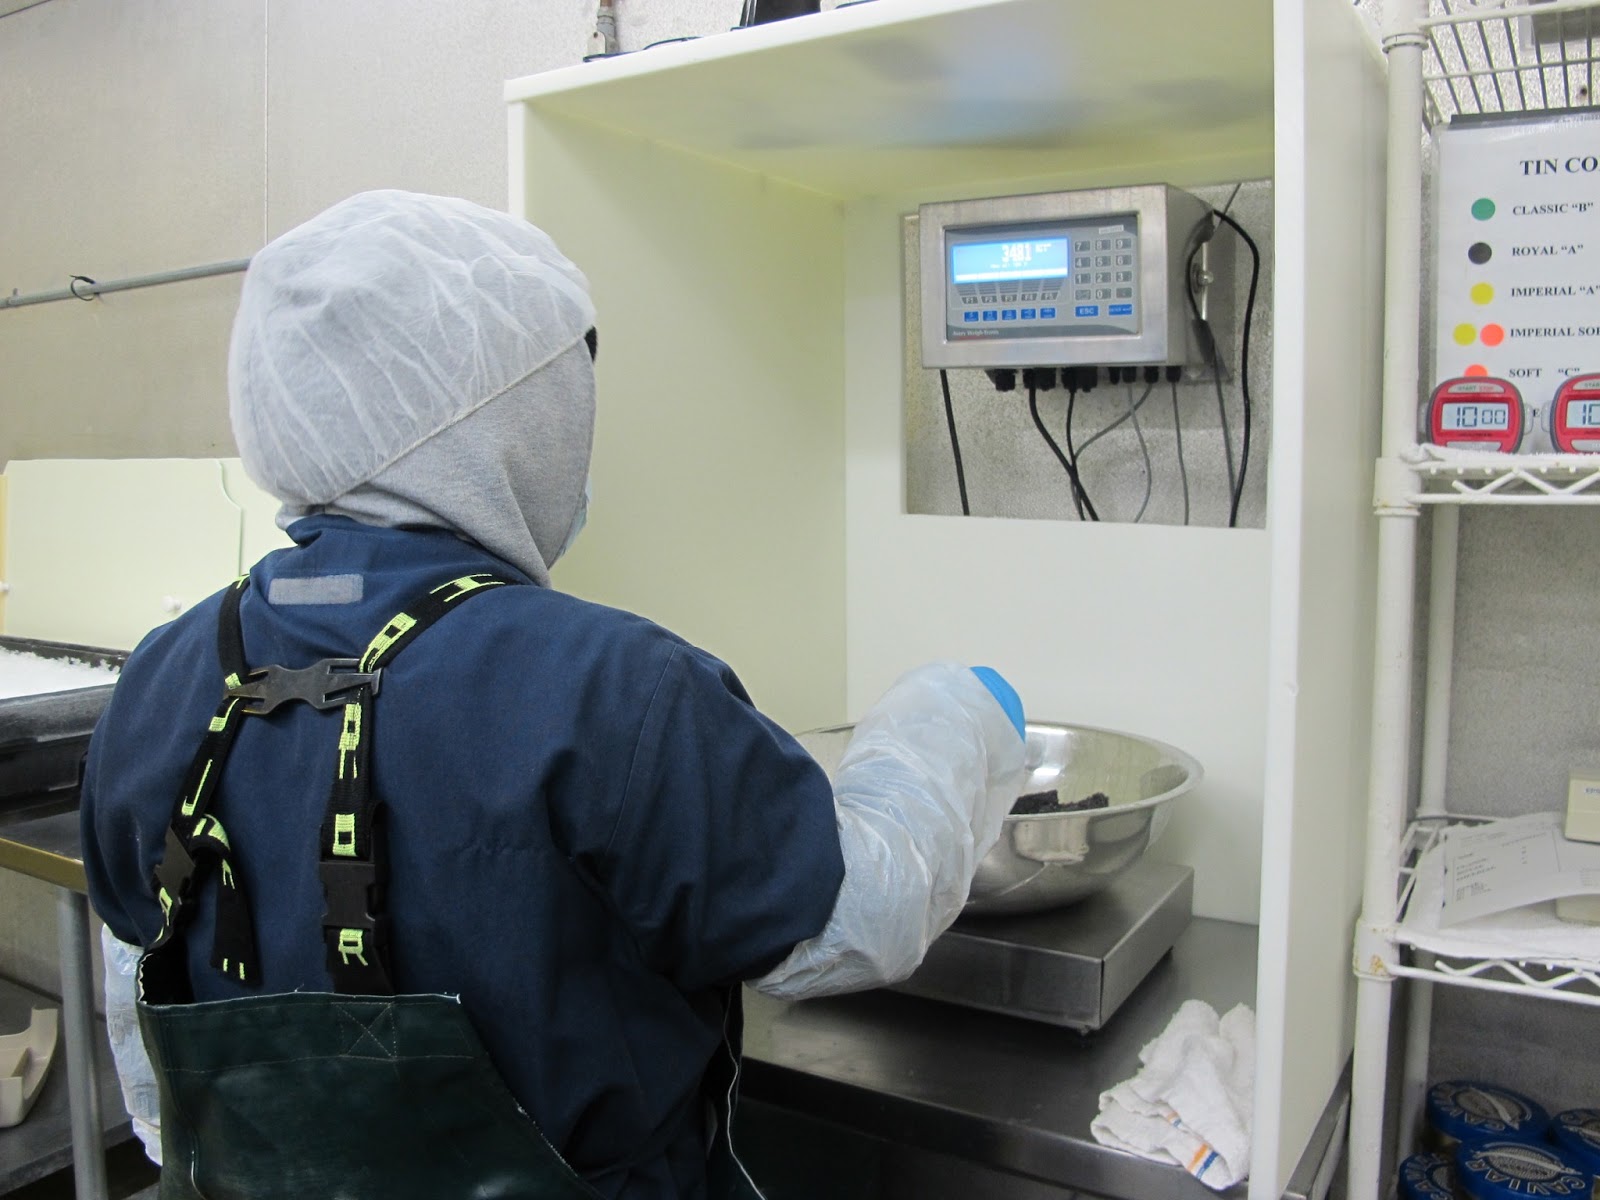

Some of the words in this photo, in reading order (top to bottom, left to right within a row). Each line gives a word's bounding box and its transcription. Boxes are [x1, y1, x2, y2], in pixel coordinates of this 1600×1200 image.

[1520, 158, 1558, 175] TIN
[1564, 156, 1600, 173] CO
[1512, 203, 1569, 216] CLASSIC
[1512, 246, 1558, 256] ROYAL
[1511, 285, 1576, 297] IMPERIAL
[1080, 306, 1095, 315] ESC
[1510, 327, 1575, 338] IMPERIAL
[1509, 368, 1542, 378] SOFT
[1456, 406, 1478, 427] 10
[1481, 409, 1506, 425] 00
